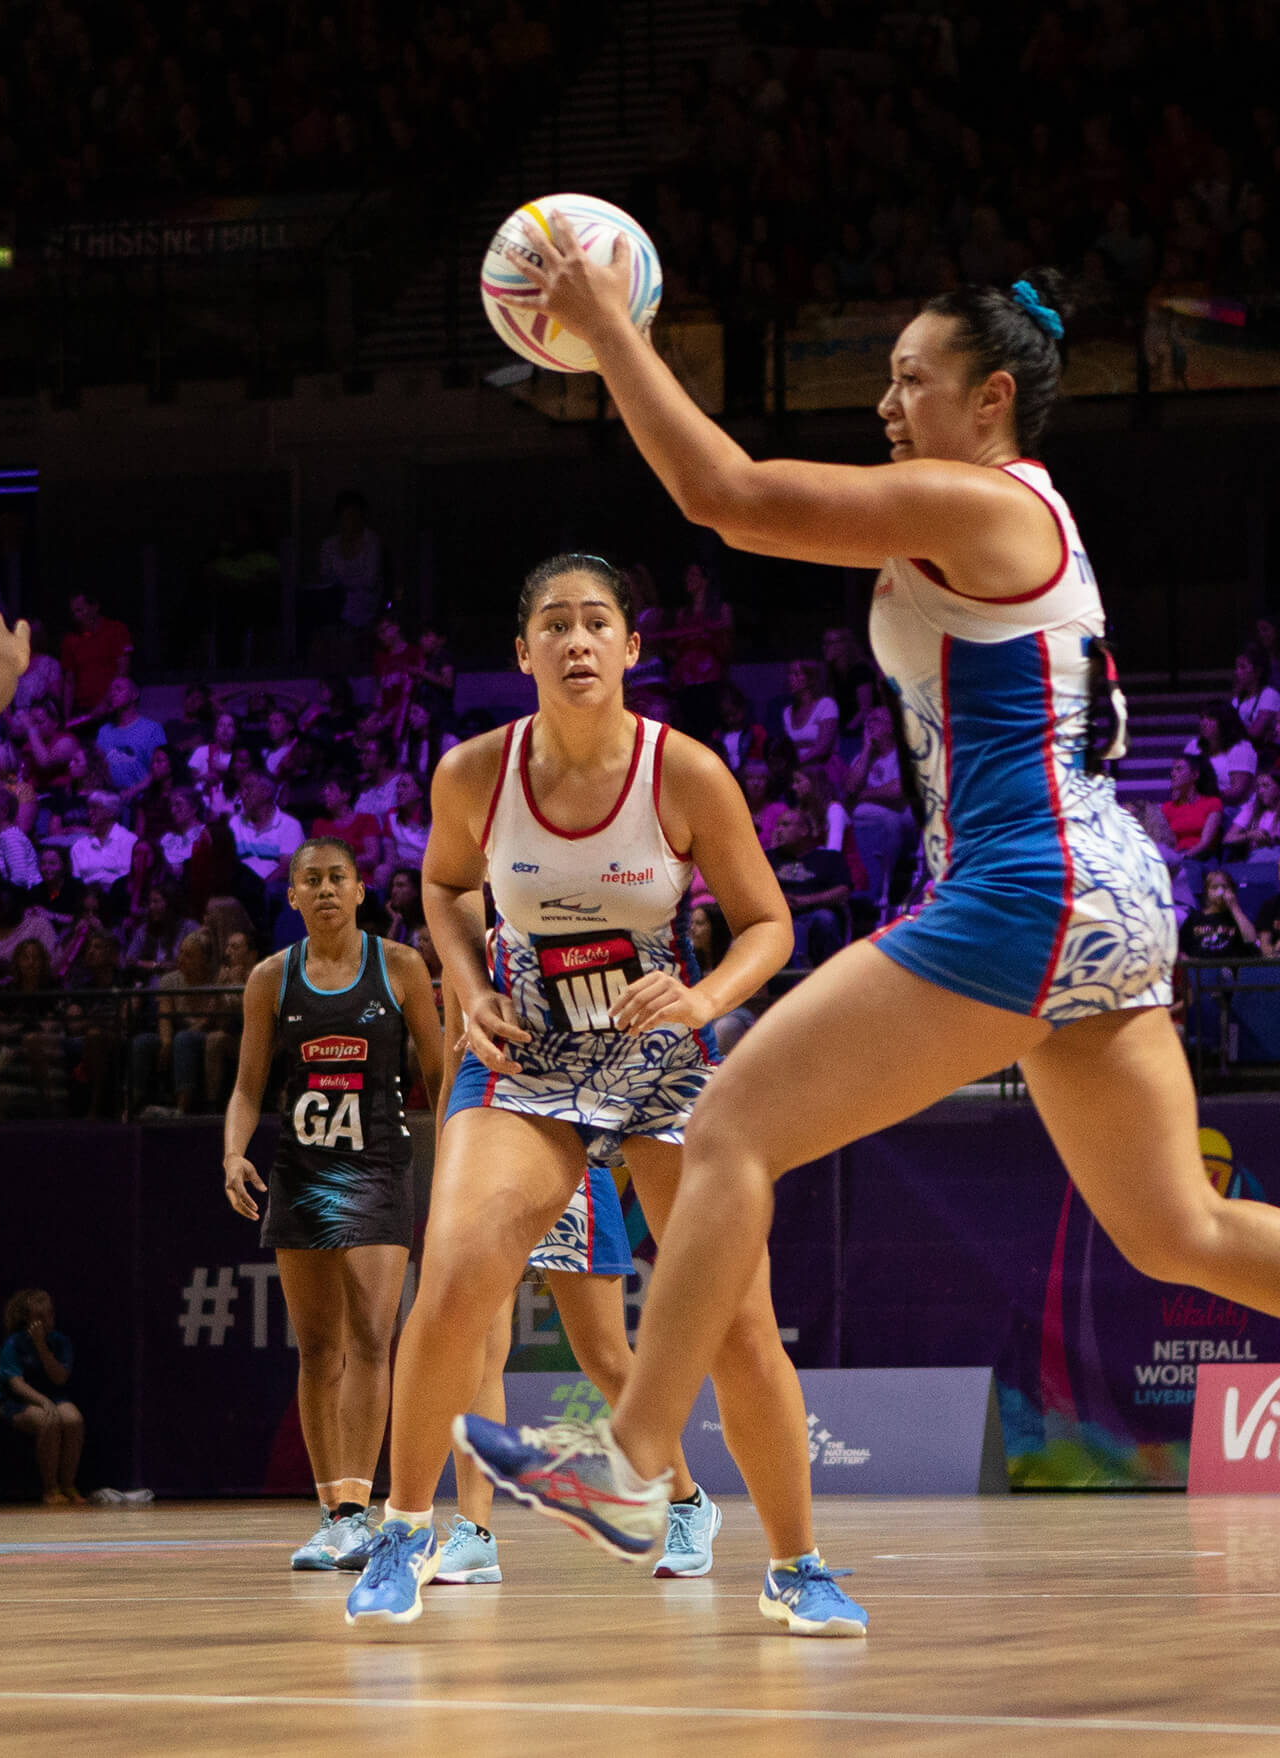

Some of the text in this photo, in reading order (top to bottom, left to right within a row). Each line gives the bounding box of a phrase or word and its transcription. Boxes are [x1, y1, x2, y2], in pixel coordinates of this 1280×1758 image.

[601, 868, 654, 885] netball
[561, 947, 610, 968] Vitality
[308, 1044, 361, 1059] Punjas
[319, 1077, 351, 1089] Vitality
[293, 1091, 364, 1150] GA
[1153, 1339, 1258, 1362] NETBALL
[823, 1456, 866, 1464] LOTTERY
[824, 1449, 871, 1457] NATIONAL
